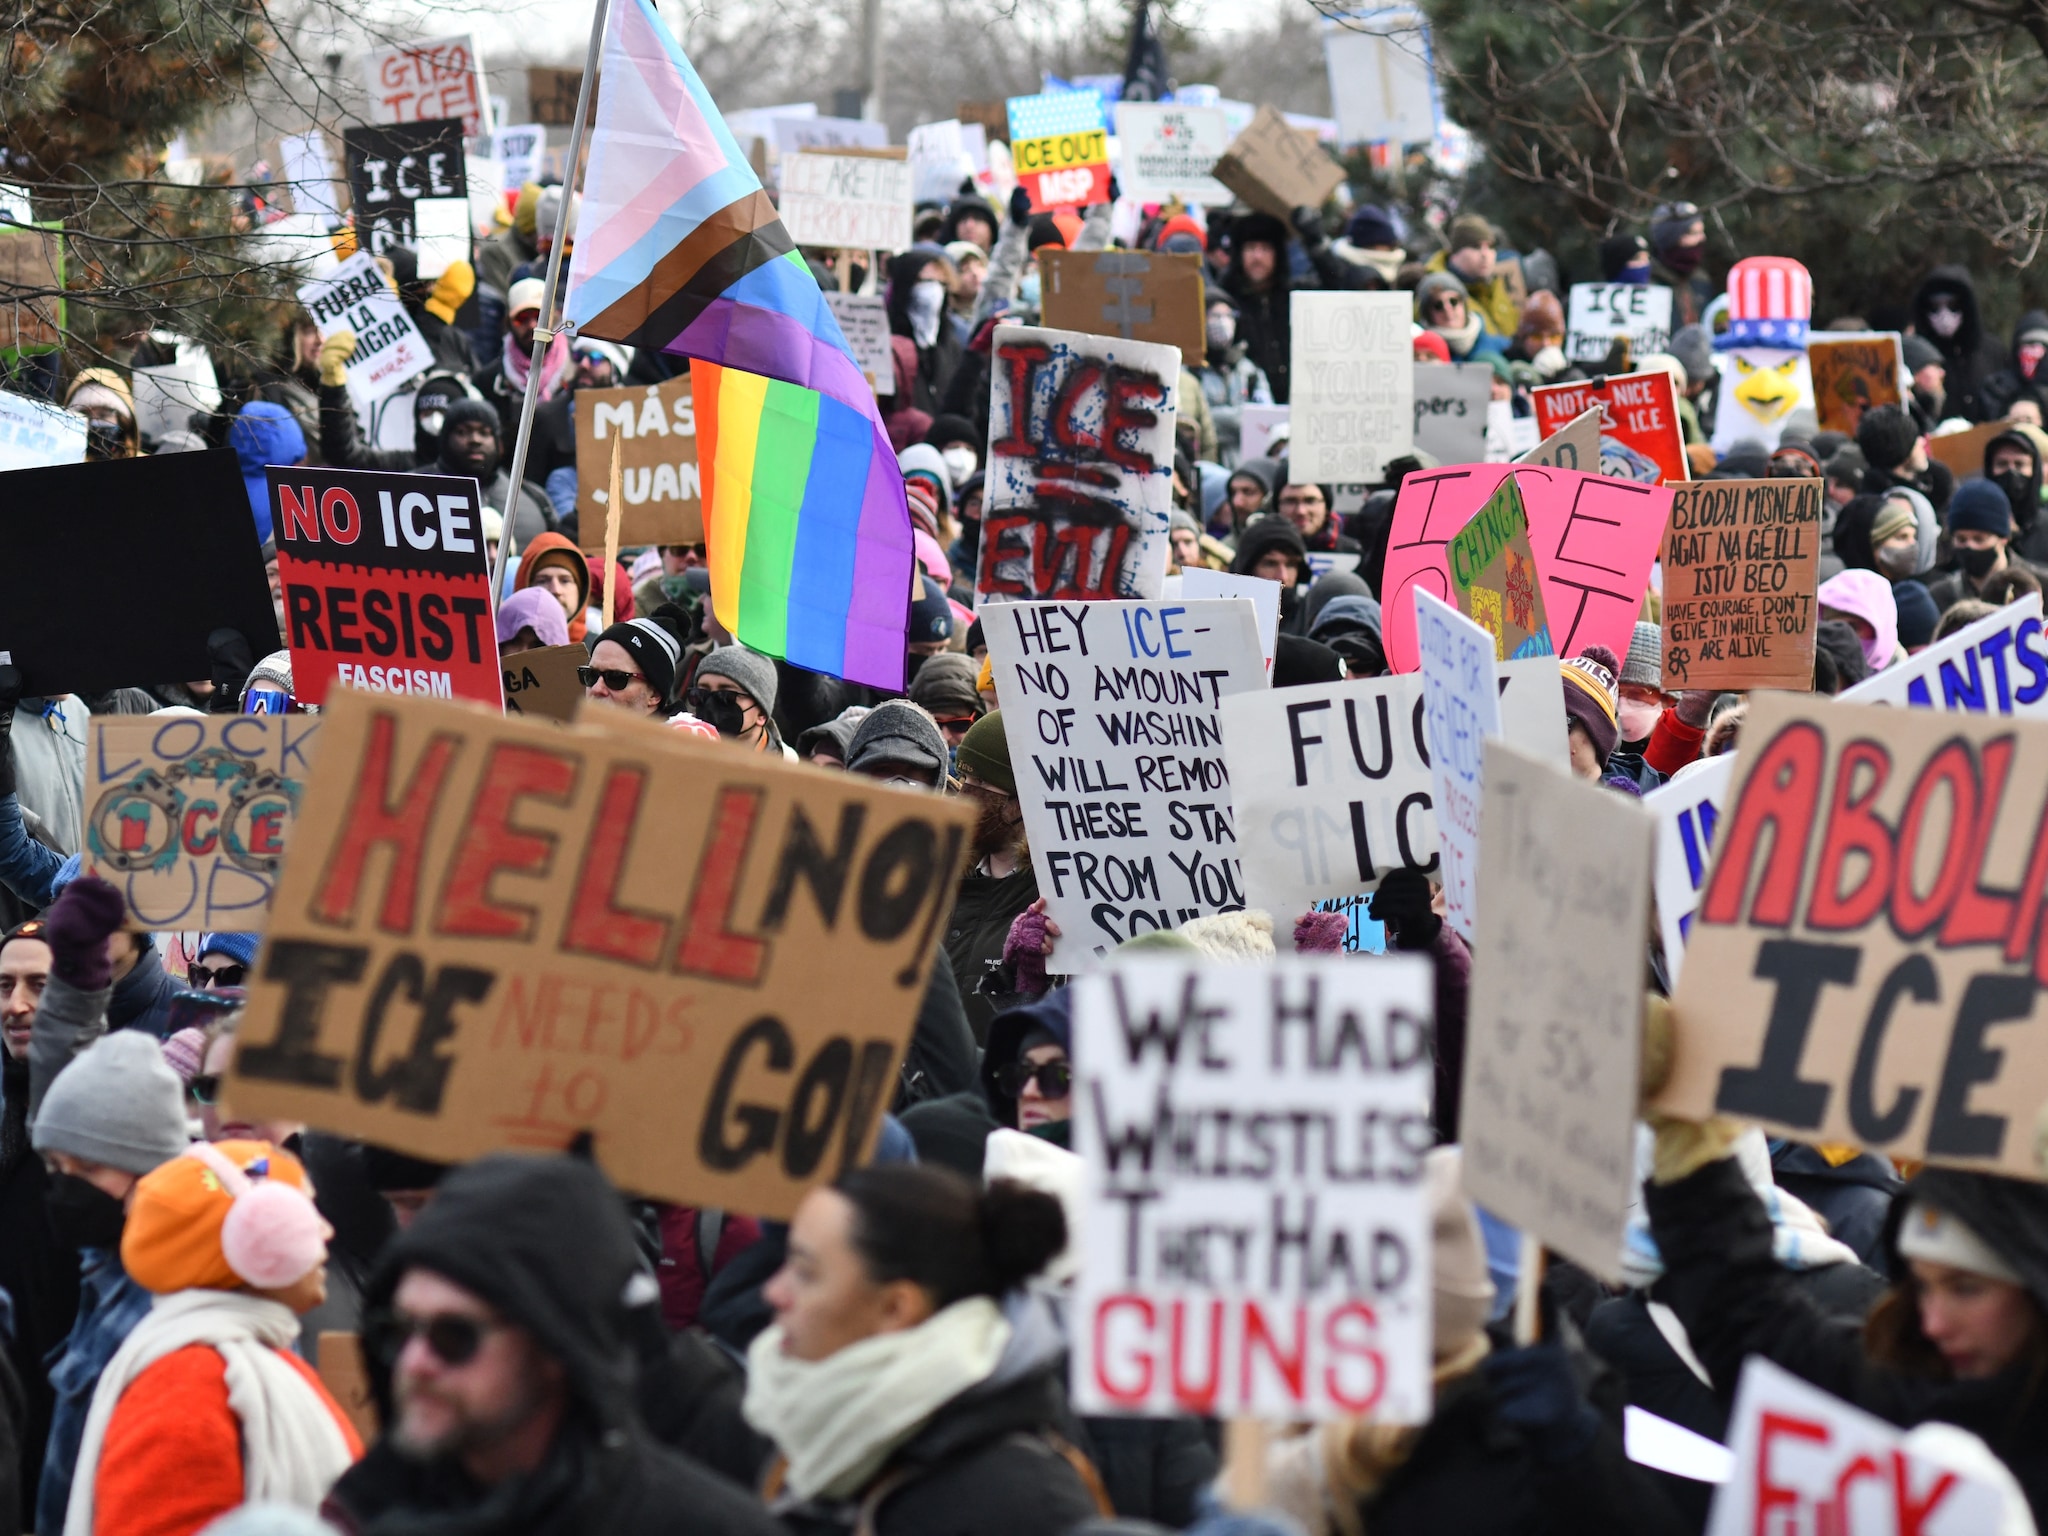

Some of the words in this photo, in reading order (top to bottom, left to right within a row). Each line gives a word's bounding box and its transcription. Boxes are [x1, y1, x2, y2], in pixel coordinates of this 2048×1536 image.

[381, 44, 469, 89] GTFO
[1014, 138, 1054, 169] ICE
[1059, 132, 1104, 163] OUT
[363, 152, 454, 202] ICE
[825, 157, 866, 198] ARE
[1038, 168, 1095, 206] MSP
[312, 267, 385, 325] FUERA
[346, 304, 377, 333] LA
[1587, 287, 1649, 315] ICE
[1303, 305, 1405, 354] LOVE
[989, 340, 1164, 476] ICE
[1304, 360, 1401, 406] YOUR
[1543, 389, 1587, 419] NOT
[1611, 381, 1656, 409] NICE
[593, 384, 697, 441] MÁS
[278, 484, 362, 546] NO
[378, 490, 476, 554] ICE
[1392, 469, 1652, 577] IE
[1672, 482, 1740, 530] BÍODH
[1453, 480, 1528, 591] CHINGA
[1668, 531, 1713, 568] AGAT
[1716, 529, 1742, 563] NA
[1745, 524, 1809, 562] GÉILL
[1743, 562, 1788, 593] BEO
[286, 583, 488, 664] RESIST
[1012, 604, 1090, 657] HEY
[1666, 602, 1698, 622] HAVE
[1762, 591, 1814, 616] DON'T
[1670, 619, 1708, 643] GIVE
[1712, 620, 1728, 638] IN
[1730, 616, 1774, 637] WHILE
[1775, 615, 1807, 635] YOU
[1699, 639, 1725, 661] ARE
[1728, 636, 1773, 659] ALIVE
[337, 662, 453, 700] FASCISM
[1015, 661, 1070, 701] NO
[1094, 665, 1230, 710] AMOUNT
[97, 717, 322, 784] LOCK
[1037, 708, 1077, 747] OF
[1095, 710, 1223, 748] WASHIN
[1031, 755, 1129, 794] WILL
[118, 800, 287, 857] ICE
[1044, 801, 1149, 842] THESE
[1167, 800, 1237, 845] STA
[1349, 791, 1441, 883] IC
[305, 706, 775, 990] HELL
[758, 799, 965, 989] NO!
[1698, 717, 2048, 992] ABOLI
[126, 856, 276, 928] UP
[1046, 851, 1161, 902] FROM
[236, 936, 498, 1116] ICE
[489, 970, 698, 1062] NEEDS
[1109, 968, 1234, 1072] WE
[1268, 970, 1436, 1074] HAD
[1713, 938, 2038, 1159] ICE
[1091, 1070, 1434, 1186] WHISTLES
[1101, 1186, 1253, 1292] THEY
[1267, 1190, 1411, 1294] HAD
[1092, 1289, 1390, 1415] GUNS
